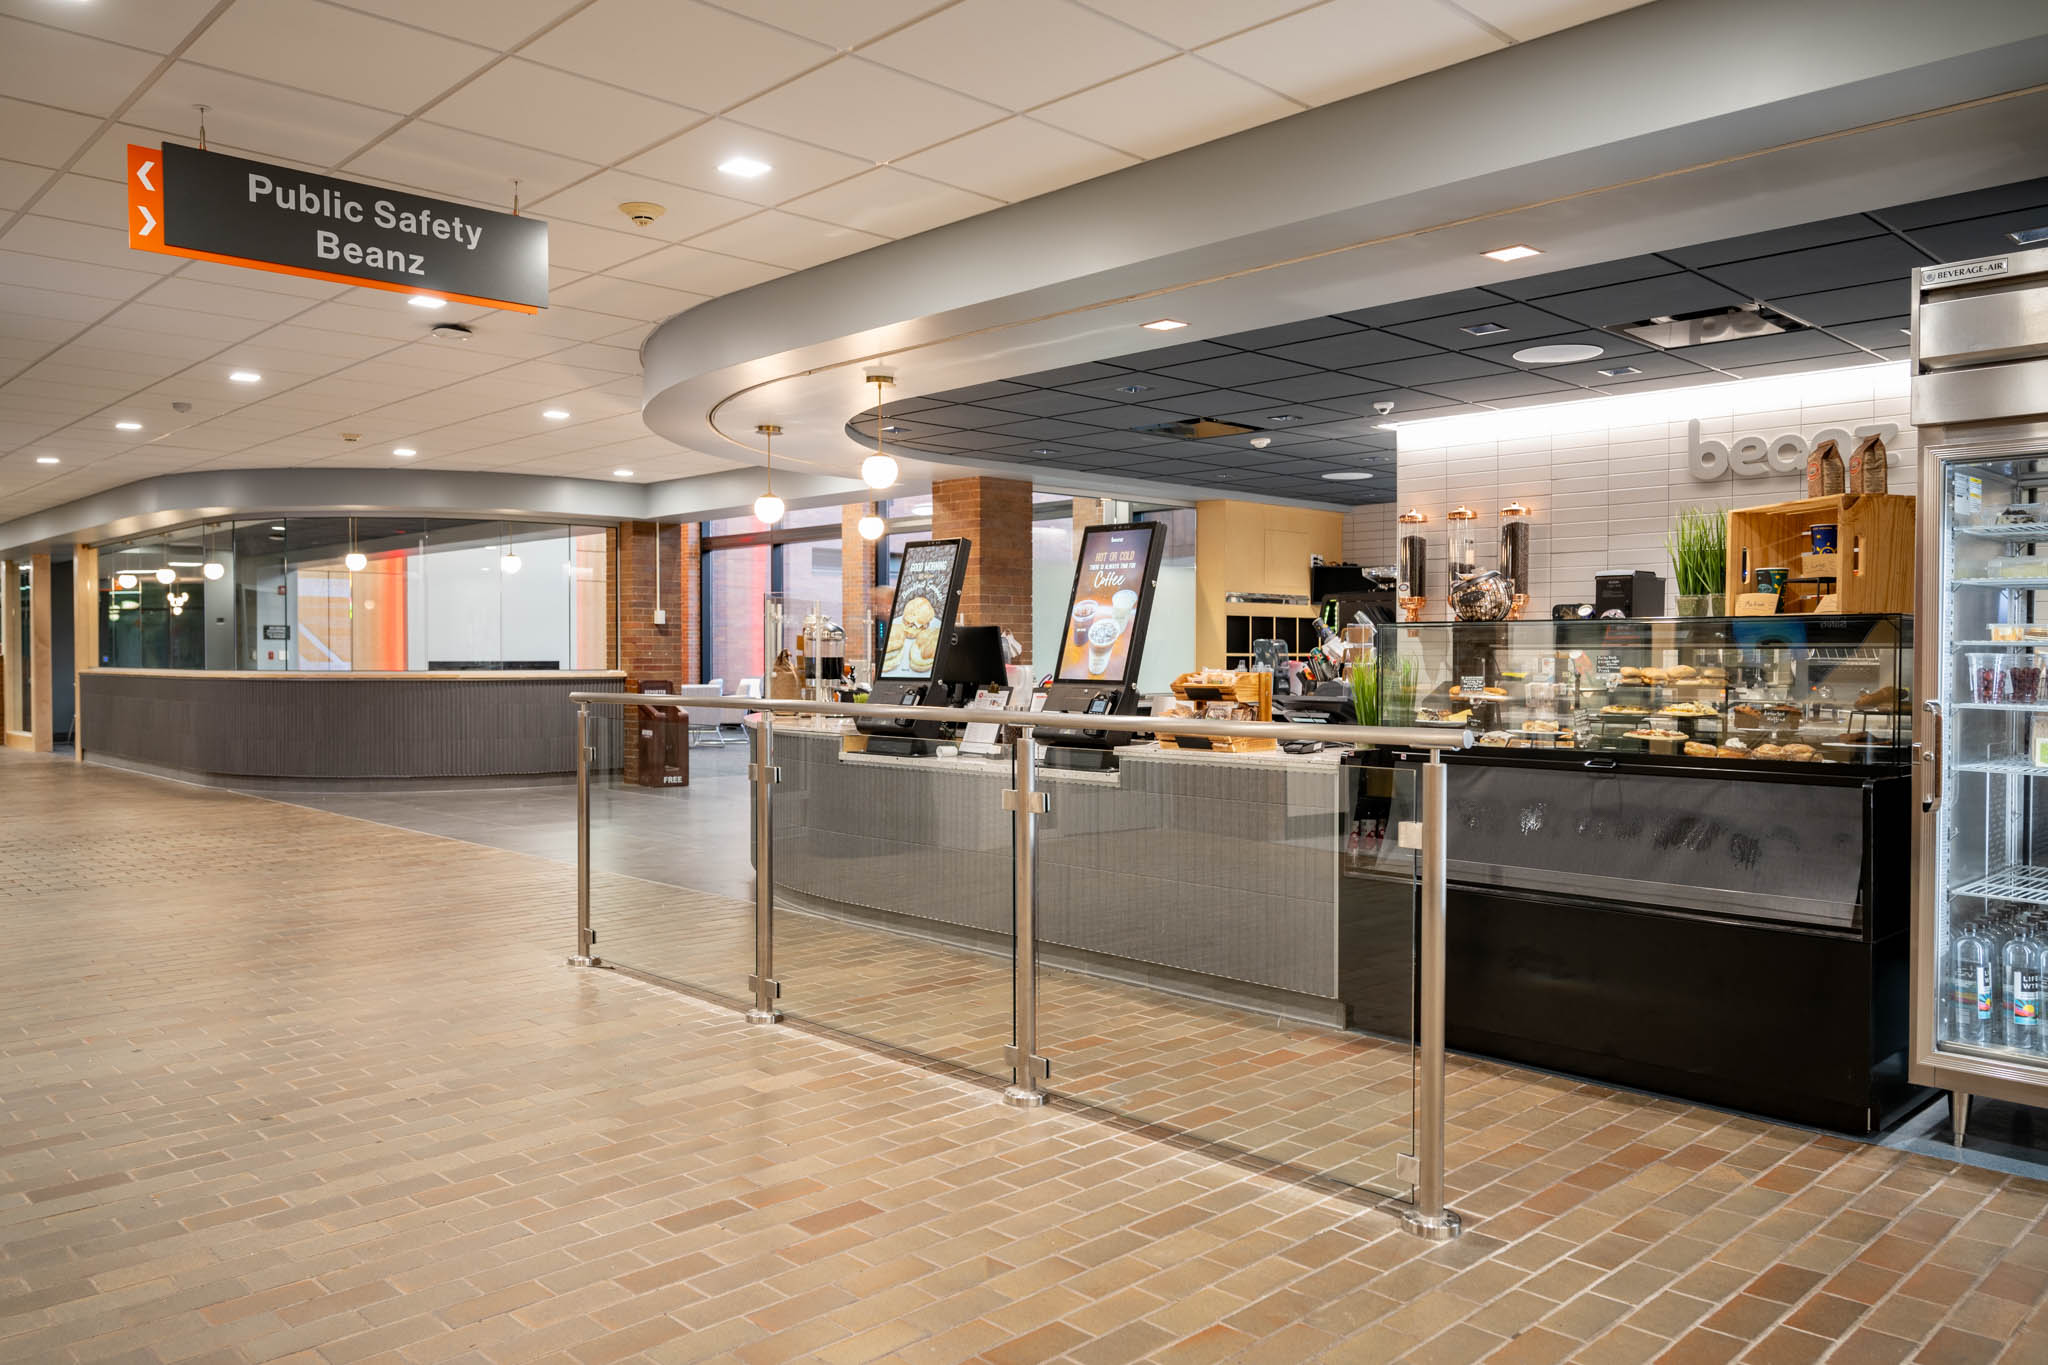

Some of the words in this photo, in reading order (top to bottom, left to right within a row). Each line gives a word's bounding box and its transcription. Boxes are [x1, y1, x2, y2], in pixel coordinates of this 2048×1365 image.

[248, 173, 364, 223] Public
[374, 200, 483, 251] Safety
[316, 229, 425, 276] Beanz
[1937, 262, 2004, 279] BEVERAGE-AIR
[1095, 551, 1107, 562] HOT
[1109, 551, 1118, 561] OR
[1119, 550, 1135, 561] COLD
[1094, 570, 1127, 589] Coffee
